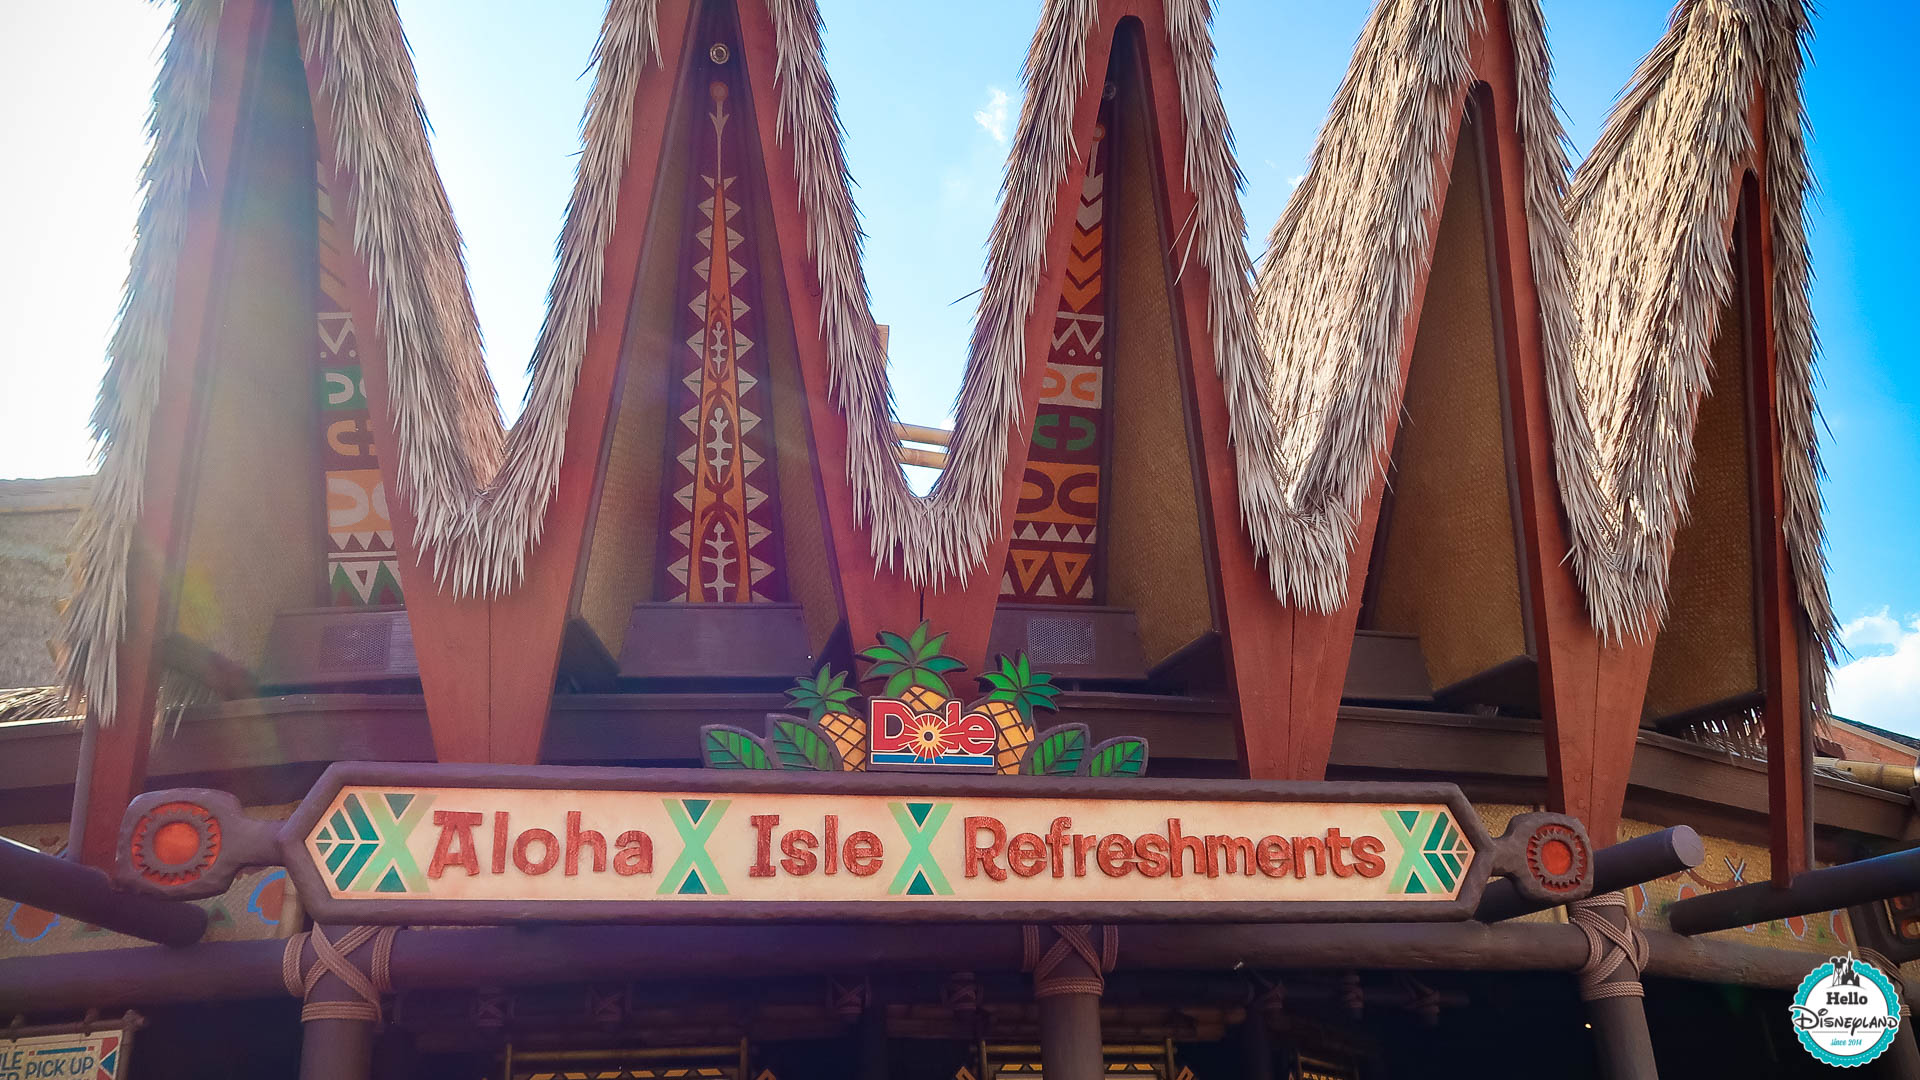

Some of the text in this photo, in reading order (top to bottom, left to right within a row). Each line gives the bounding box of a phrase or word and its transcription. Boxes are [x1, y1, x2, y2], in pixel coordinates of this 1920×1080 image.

[871, 699, 997, 756] Dole
[427, 810, 1387, 882] Aloha Isle Refreshments
[25, 1056, 94, 1079] PICK UP
